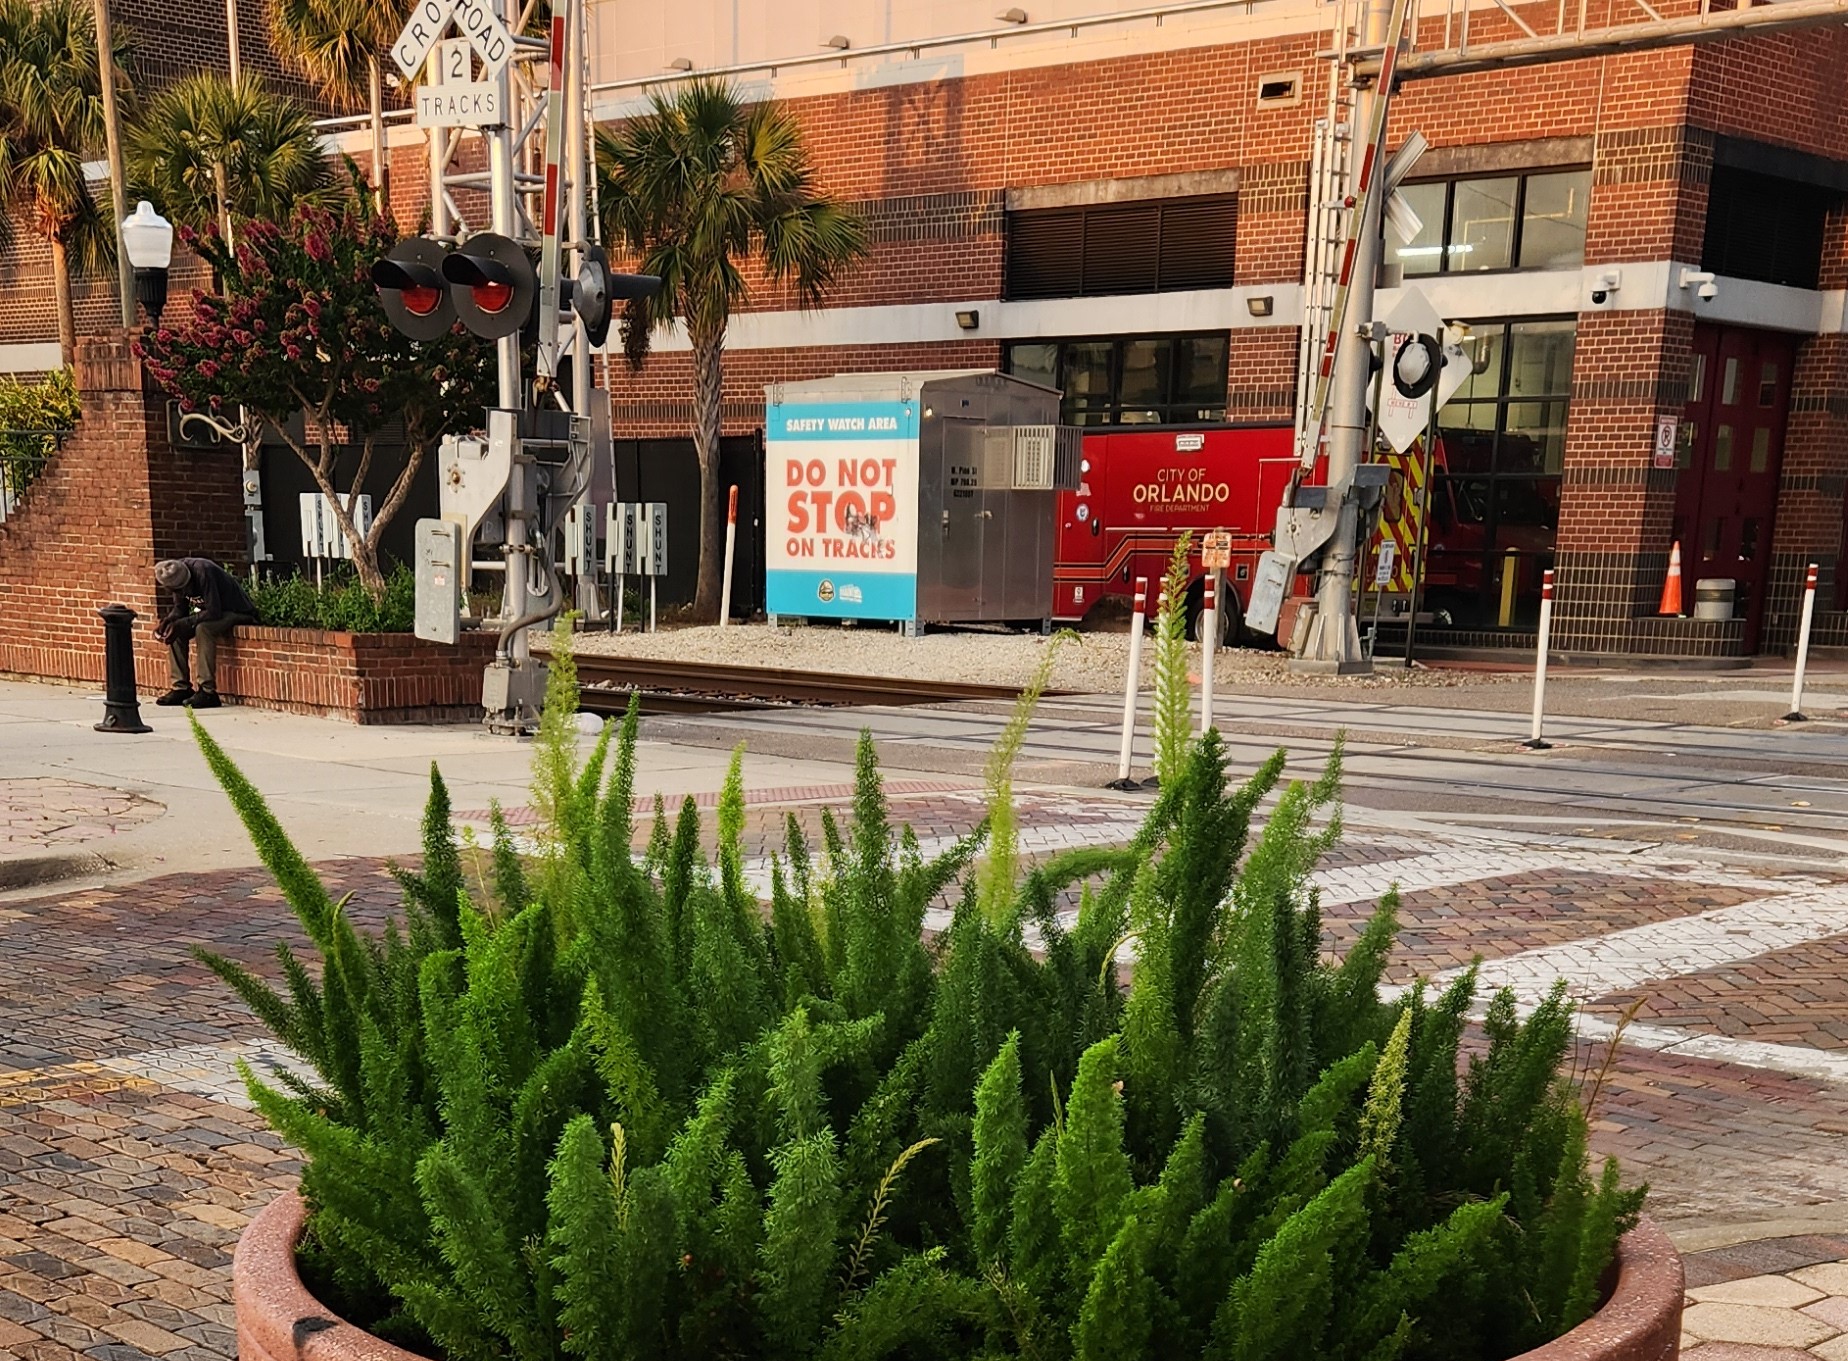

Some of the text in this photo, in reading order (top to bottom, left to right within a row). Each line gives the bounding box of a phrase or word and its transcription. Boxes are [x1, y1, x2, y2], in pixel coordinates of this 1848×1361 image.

[400, 0, 451, 67] CRO
[451, 50, 463, 78] 2
[422, 93, 495, 117] TRACKS
[786, 417, 897, 432] SAFETY WATCH AREA
[786, 458, 897, 487] DO NOT
[1157, 467, 1206, 482] CITY OF
[1133, 482, 1230, 503] ORLANDO
[787, 490, 896, 534] STOP
[1149, 504, 1210, 513] FIRE DEPARTMENT
[786, 537, 814, 558] ON
